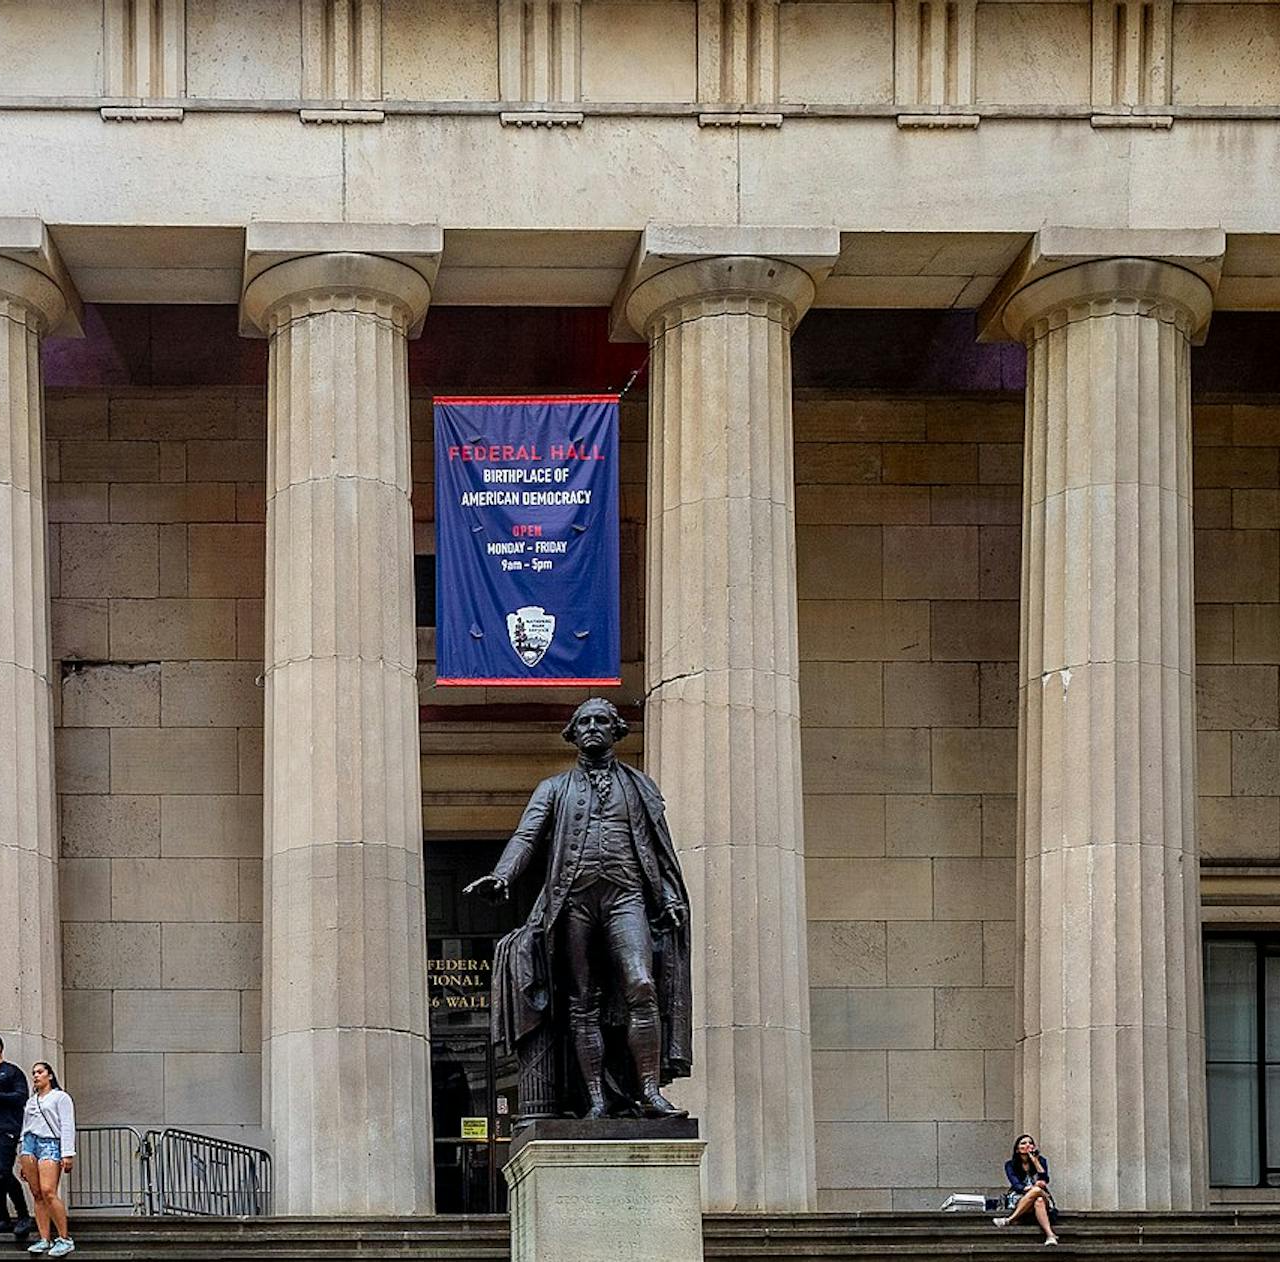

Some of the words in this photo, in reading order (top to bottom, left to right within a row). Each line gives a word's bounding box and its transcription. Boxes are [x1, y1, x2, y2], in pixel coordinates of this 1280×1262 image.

[448, 445, 542, 461] FEDERAL
[550, 444, 605, 461] HALL
[483, 468, 552, 483] BIRTHPLACE
[554, 468, 569, 482] OF
[461, 490, 520, 506] AMERICAN
[522, 490, 592, 505] DEMOCRACY
[512, 525, 542, 537] OPEN
[487, 541, 525, 555] MONDAY
[535, 541, 567, 553] FRIDAY
[501, 559, 522, 571] 9am
[531, 558, 552, 572] 5pm
[427, 960, 490, 971] FEDERA
[428, 975, 484, 986] IONAL
[446, 996, 490, 1008] WALL
